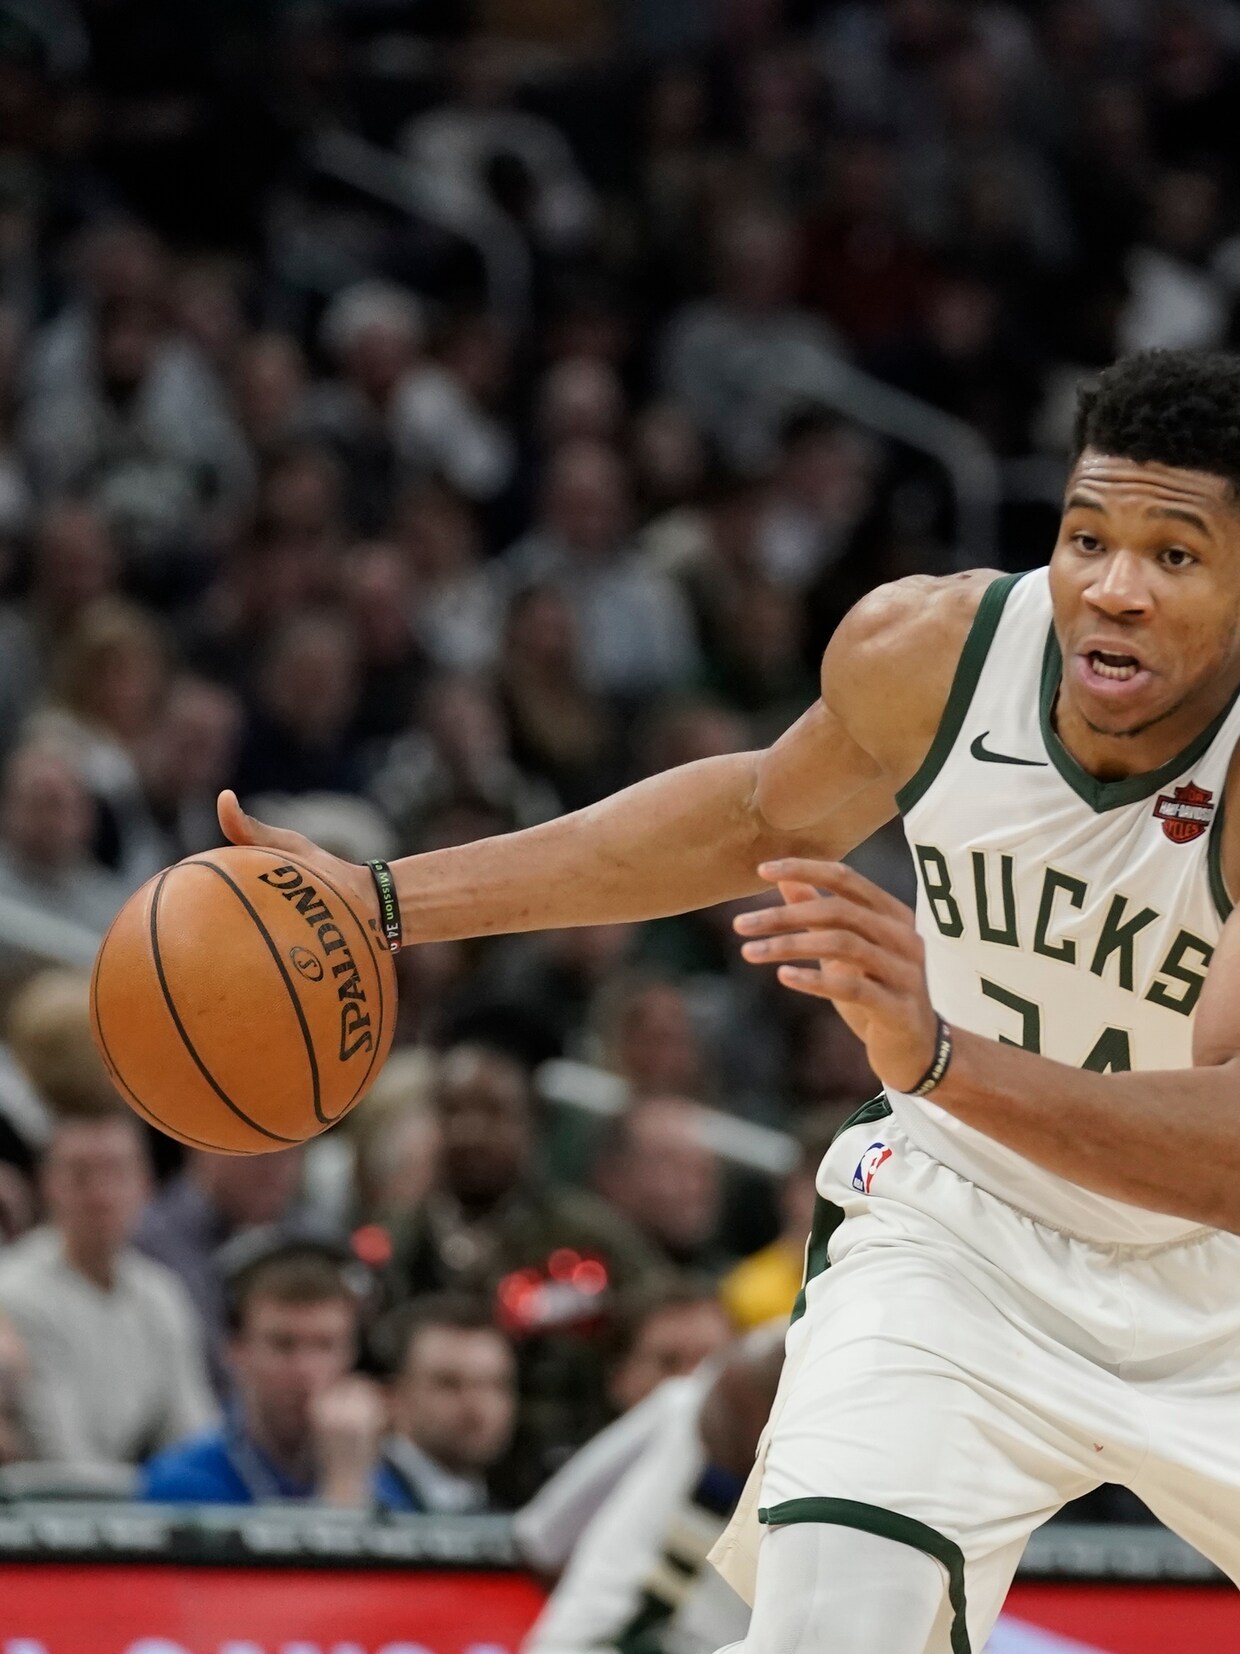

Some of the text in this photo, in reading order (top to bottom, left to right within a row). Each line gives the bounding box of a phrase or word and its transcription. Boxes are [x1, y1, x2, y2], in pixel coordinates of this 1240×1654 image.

[379, 872, 394, 920] Mission
[386, 922, 399, 939] 34
[915, 844, 1215, 1017] BUCKS
[259, 865, 374, 1062] SPALDING
